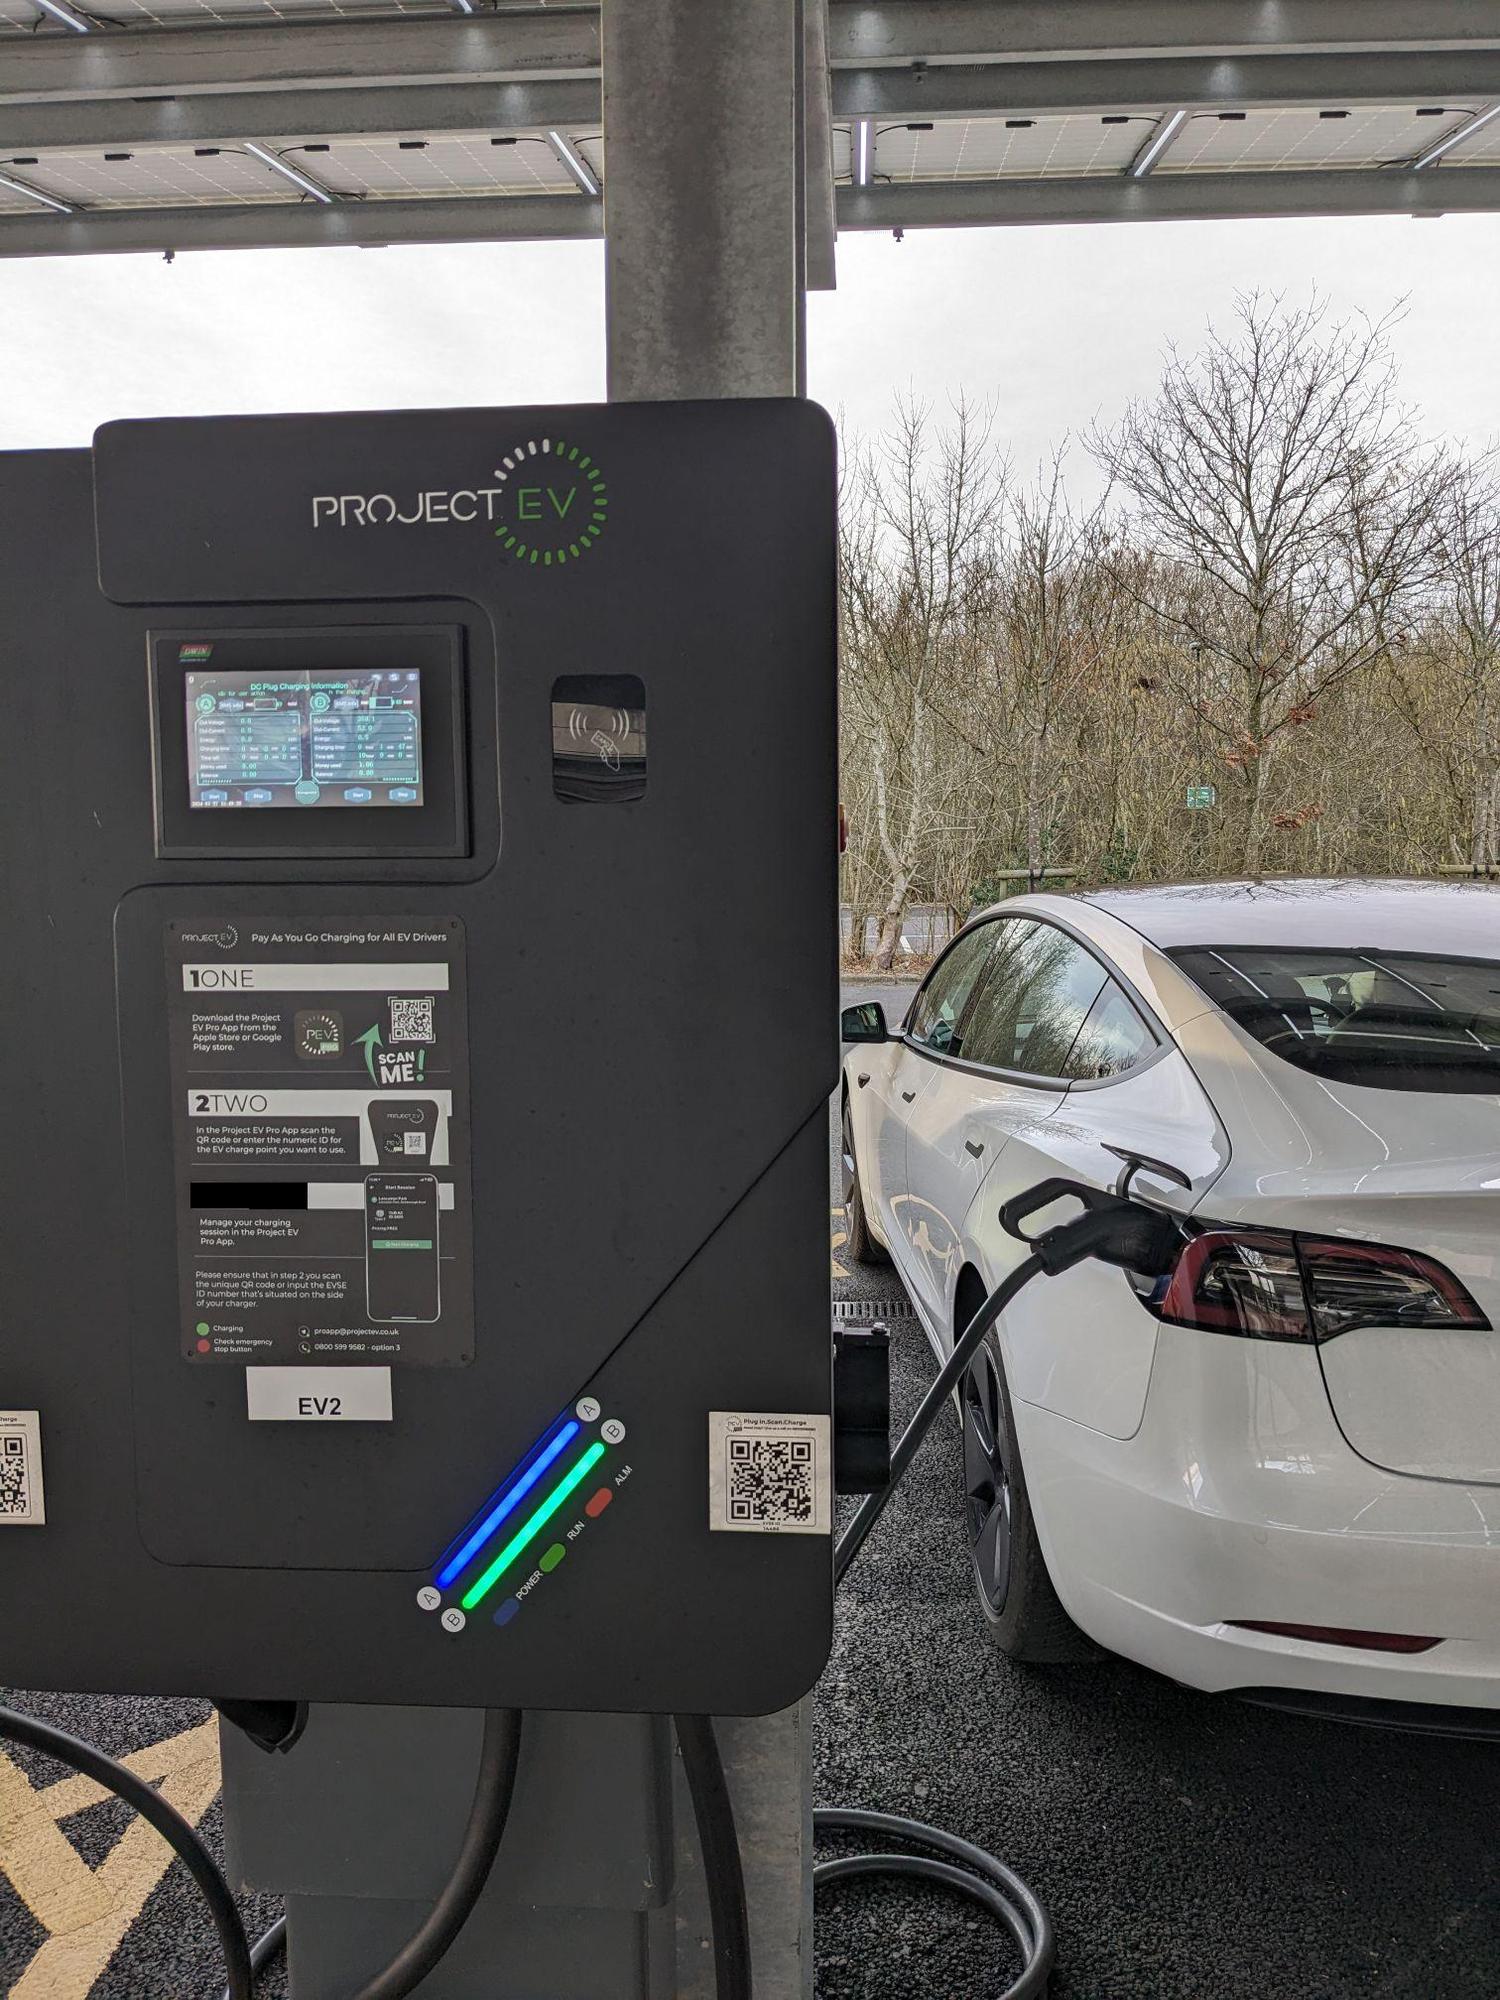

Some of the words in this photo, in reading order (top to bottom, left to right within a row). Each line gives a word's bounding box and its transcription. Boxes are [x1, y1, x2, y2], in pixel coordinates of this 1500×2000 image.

[313, 489, 502, 527] PROJECT
[518, 488, 577, 519] EV
[263, 682, 278, 691] Plug
[280, 682, 310, 691] Charging
[182, 934, 218, 942] PROJECT
[221, 932, 232, 940] EV
[251, 933, 269, 944] Pay
[271, 933, 283, 942] As
[285, 933, 303, 942] You
[305, 933, 319, 942] Go
[320, 933, 365, 944] Charging
[367, 932, 380, 942] for
[383, 933, 395, 942] All
[398, 933, 411, 942] EV
[413, 932, 447, 942] Drivers
[192, 1013, 234, 1022] Download
[235, 1014, 249, 1022] the
[251, 1013, 281, 1023] Project
[192, 1024, 205, 1032] EV
[205, 1024, 219, 1032] Pro
[221, 1024, 239, 1034] App
[240, 1023, 261, 1032] from
[262, 1023, 277, 1032] the
[192, 1033, 217, 1043] Apple
[218, 1033, 240, 1041] Store
[252, 1033, 282, 1044] Google
[306, 1029, 332, 1040] PEV
[193, 1043, 211, 1053] Play
[212, 1043, 235, 1051] store.
[378, 1051, 415, 1065] SCAN
[196, 1126, 204, 1134] In
[206, 1126, 220, 1134] the
[221, 1126, 251, 1136] Project
[253, 1126, 264, 1134] EV
[266, 1126, 280, 1134] Pro
[282, 1126, 299, 1136] App
[300, 1127, 319, 1135] scan
[321, 1126, 336, 1135] the
[196, 1135, 210, 1145] QR
[211, 1135, 231, 1144] code
[267, 1136, 281, 1144] the
[282, 1136, 318, 1144] numeric
[319, 1136, 329, 1144] ID
[330, 1136, 341, 1144] for
[197, 1145, 211, 1153] the
[225, 1145, 254, 1155] charge
[256, 1146, 278, 1155] point
[279, 1147, 294, 1155] you
[296, 1146, 317, 1154] want
[319, 1146, 328, 1154] to
[200, 1219, 233, 1228] Manage
[234, 1220, 253, 1228] your
[254, 1218, 291, 1228] charging
[200, 1228, 229, 1236] session
[231, 1228, 239, 1236] in
[241, 1228, 255, 1236] the
[256, 1228, 285, 1238] Project
[195, 1271, 221, 1279] Please
[252, 1271, 269, 1279] that
[280, 1272, 298, 1280] step
[299, 1271, 305, 1279] 2
[211, 1281, 239, 1289] unique
[241, 1281, 253, 1289] QR
[256, 1281, 275, 1289] code
[287, 1281, 309, 1290] input
[311, 1281, 325, 1289] the
[326, 1281, 347, 1289] EVSE
[196, 1290, 206, 1298] ID
[207, 1290, 239, 1298] number
[241, 1289, 263, 1298] that's
[265, 1290, 298, 1298] situated
[312, 1291, 326, 1299] the
[327, 1291, 344, 1299] side
[196, 1299, 205, 1307] of
[225, 1299, 258, 1309] charger.
[213, 1325, 244, 1333] Charging
[314, 1328, 399, 1336] proapp@projectev.co.uk
[348, 1343, 366, 1351] 9582
[371, 1344, 395, 1352] option
[299, 1397, 342, 1416] EV2
[582, 1403, 596, 1416] A
[606, 1424, 621, 1438] B
[614, 1465, 633, 1486] ALM
[566, 1520, 586, 1542] RUN
[515, 1570, 544, 1601] POWER
[423, 1592, 437, 1605] A
[447, 1612, 461, 1627] B
